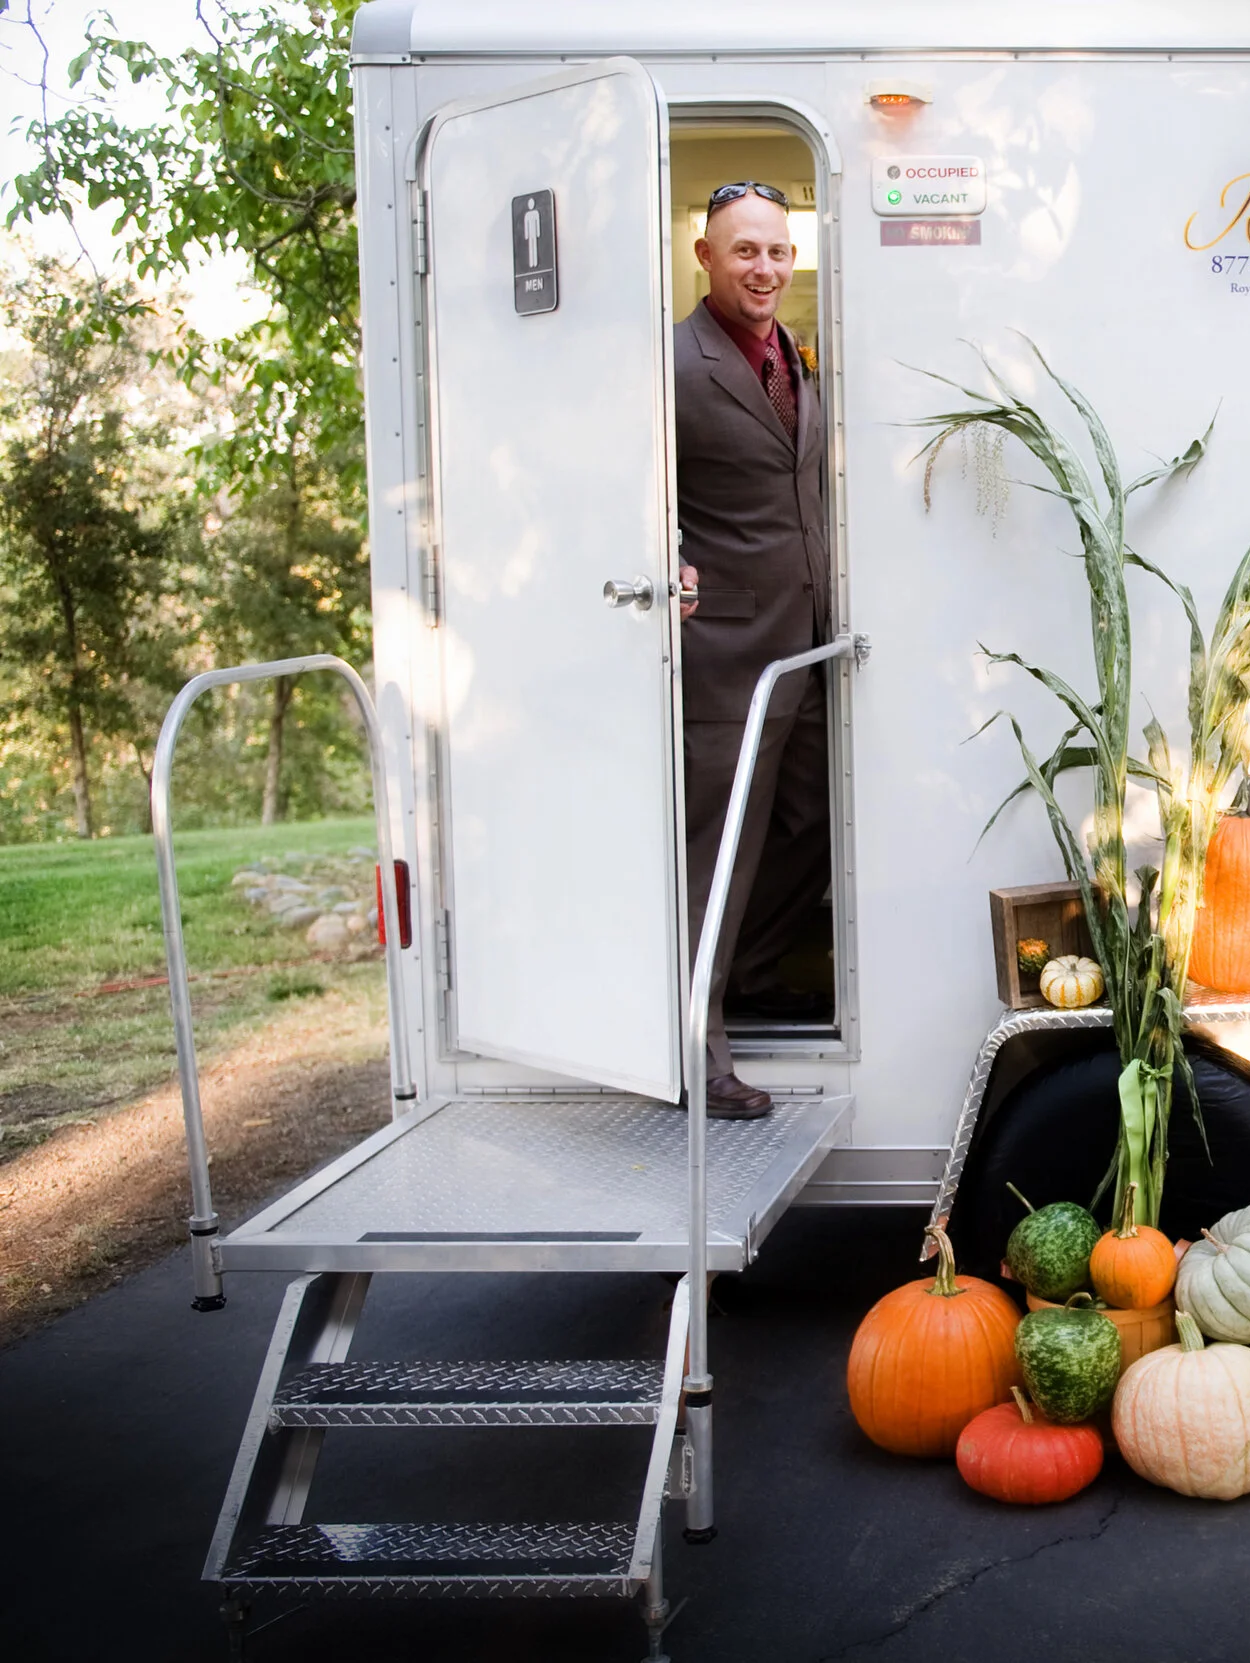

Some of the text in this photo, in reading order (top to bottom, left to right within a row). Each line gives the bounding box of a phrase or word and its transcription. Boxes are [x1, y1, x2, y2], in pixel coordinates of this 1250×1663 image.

[905, 167, 979, 179] OCCUPIED
[912, 193, 969, 204] VACANT
[525, 277, 544, 293] MEN
